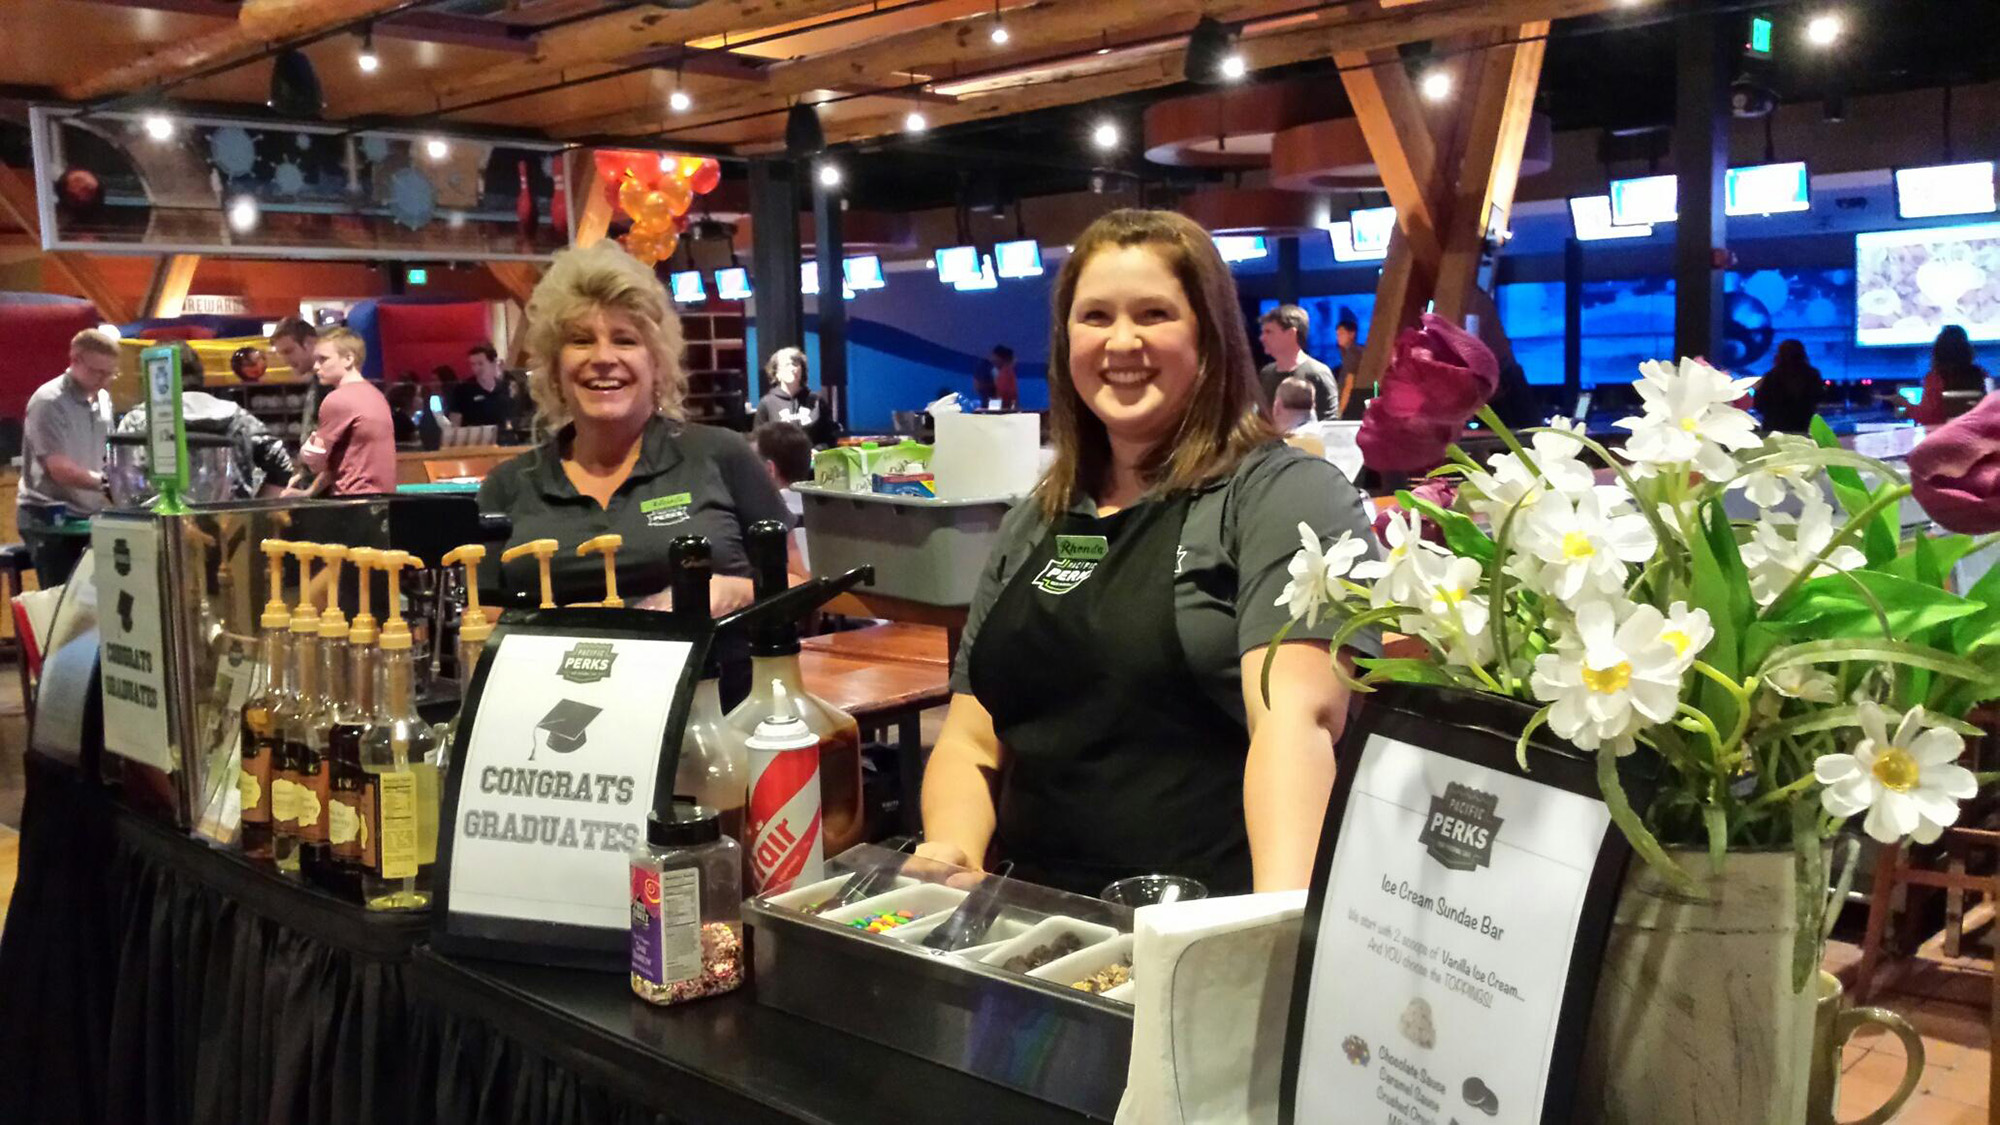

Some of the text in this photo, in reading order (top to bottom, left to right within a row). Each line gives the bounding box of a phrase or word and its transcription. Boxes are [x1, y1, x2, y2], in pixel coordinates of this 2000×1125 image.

[1061, 541, 1104, 556] Rhonda
[565, 657, 609, 670] PERKS
[480, 765, 635, 806] CONGRATS
[464, 809, 640, 852] GRADUATES
[1448, 798, 1486, 821] PACIFIC
[1430, 812, 1490, 850] PERKS
[1381, 873, 1504, 941] Ice Cream Sundae Bar
[1367, 936, 1383, 957] And
[1384, 944, 1402, 965] YOU
[1444, 973, 1494, 1009] TOPPINGS!
[1393, 928, 1402, 942] 2
[1402, 936, 1428, 958] scoops
[1442, 949, 1471, 976] Vanilla
[1472, 964, 1486, 983] Ice
[1379, 1045, 1446, 1095] Chocolate Sauce
[1380, 1066, 1440, 1113] Caramel Sauce
[1376, 1085, 1409, 1116] Crushed
